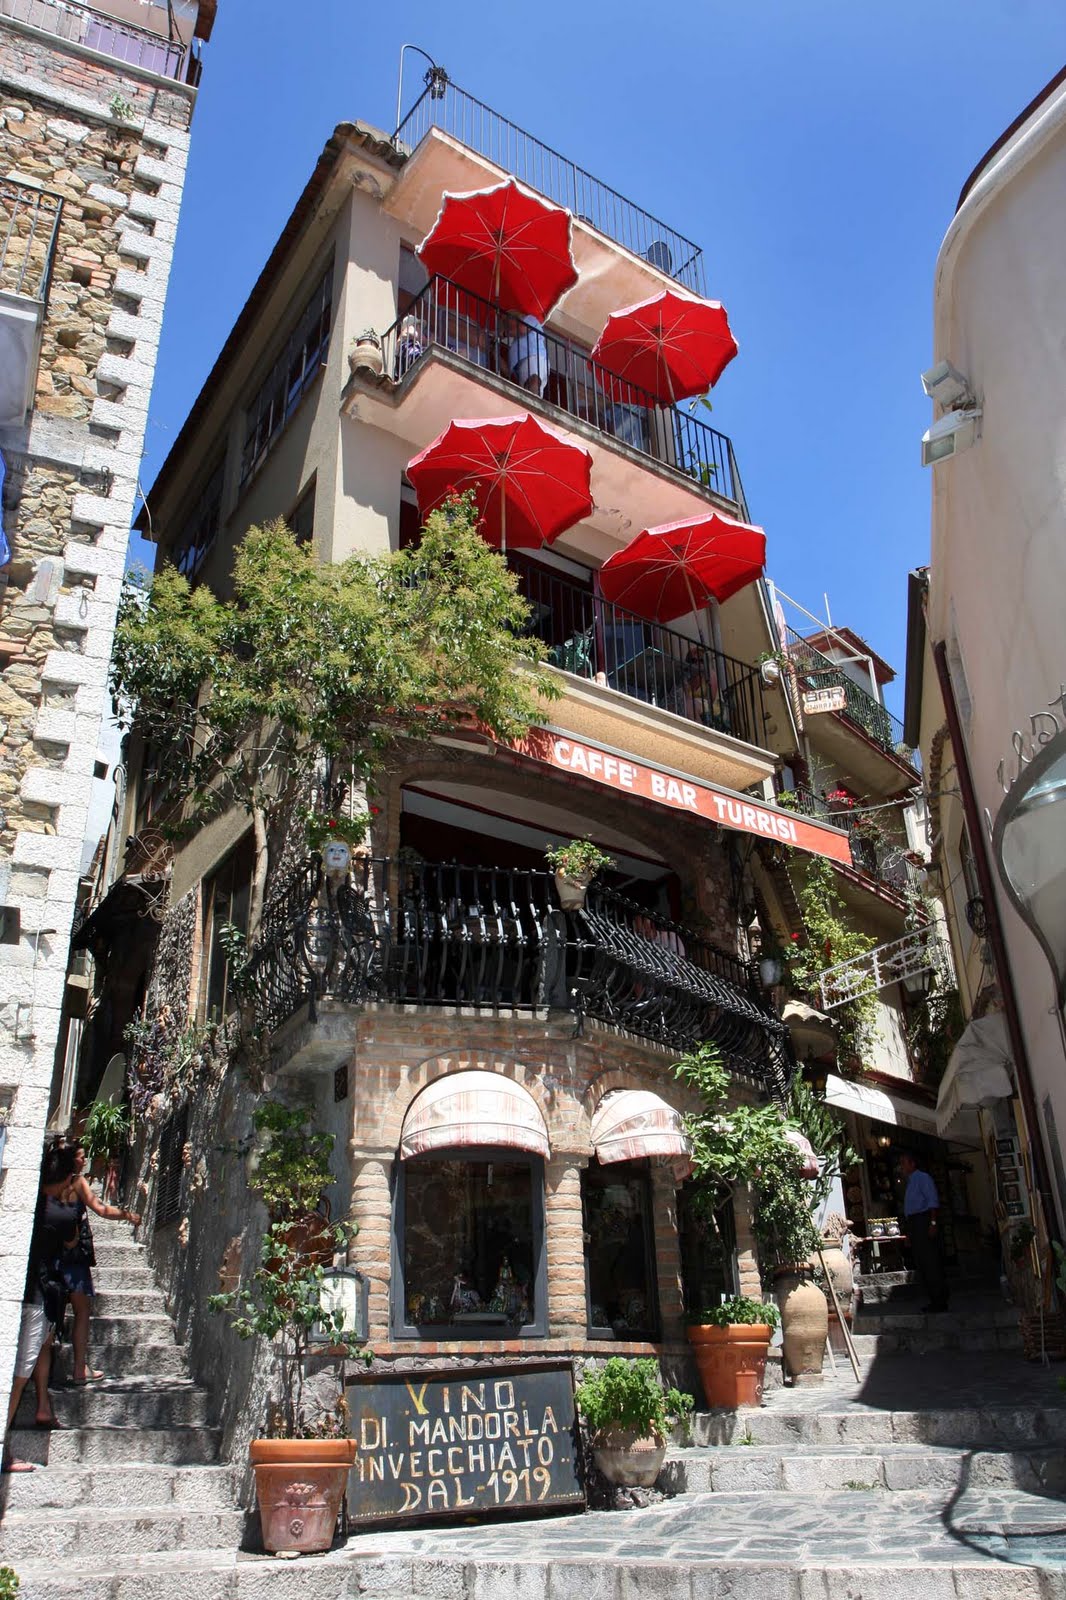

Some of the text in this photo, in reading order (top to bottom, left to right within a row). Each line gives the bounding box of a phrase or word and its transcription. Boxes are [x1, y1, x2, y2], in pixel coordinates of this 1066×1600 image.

[807, 688, 842, 702] BAR
[554, 742, 797, 842] CAFFE' BAR TURRISI
[404, 1377, 515, 1415] VINO
